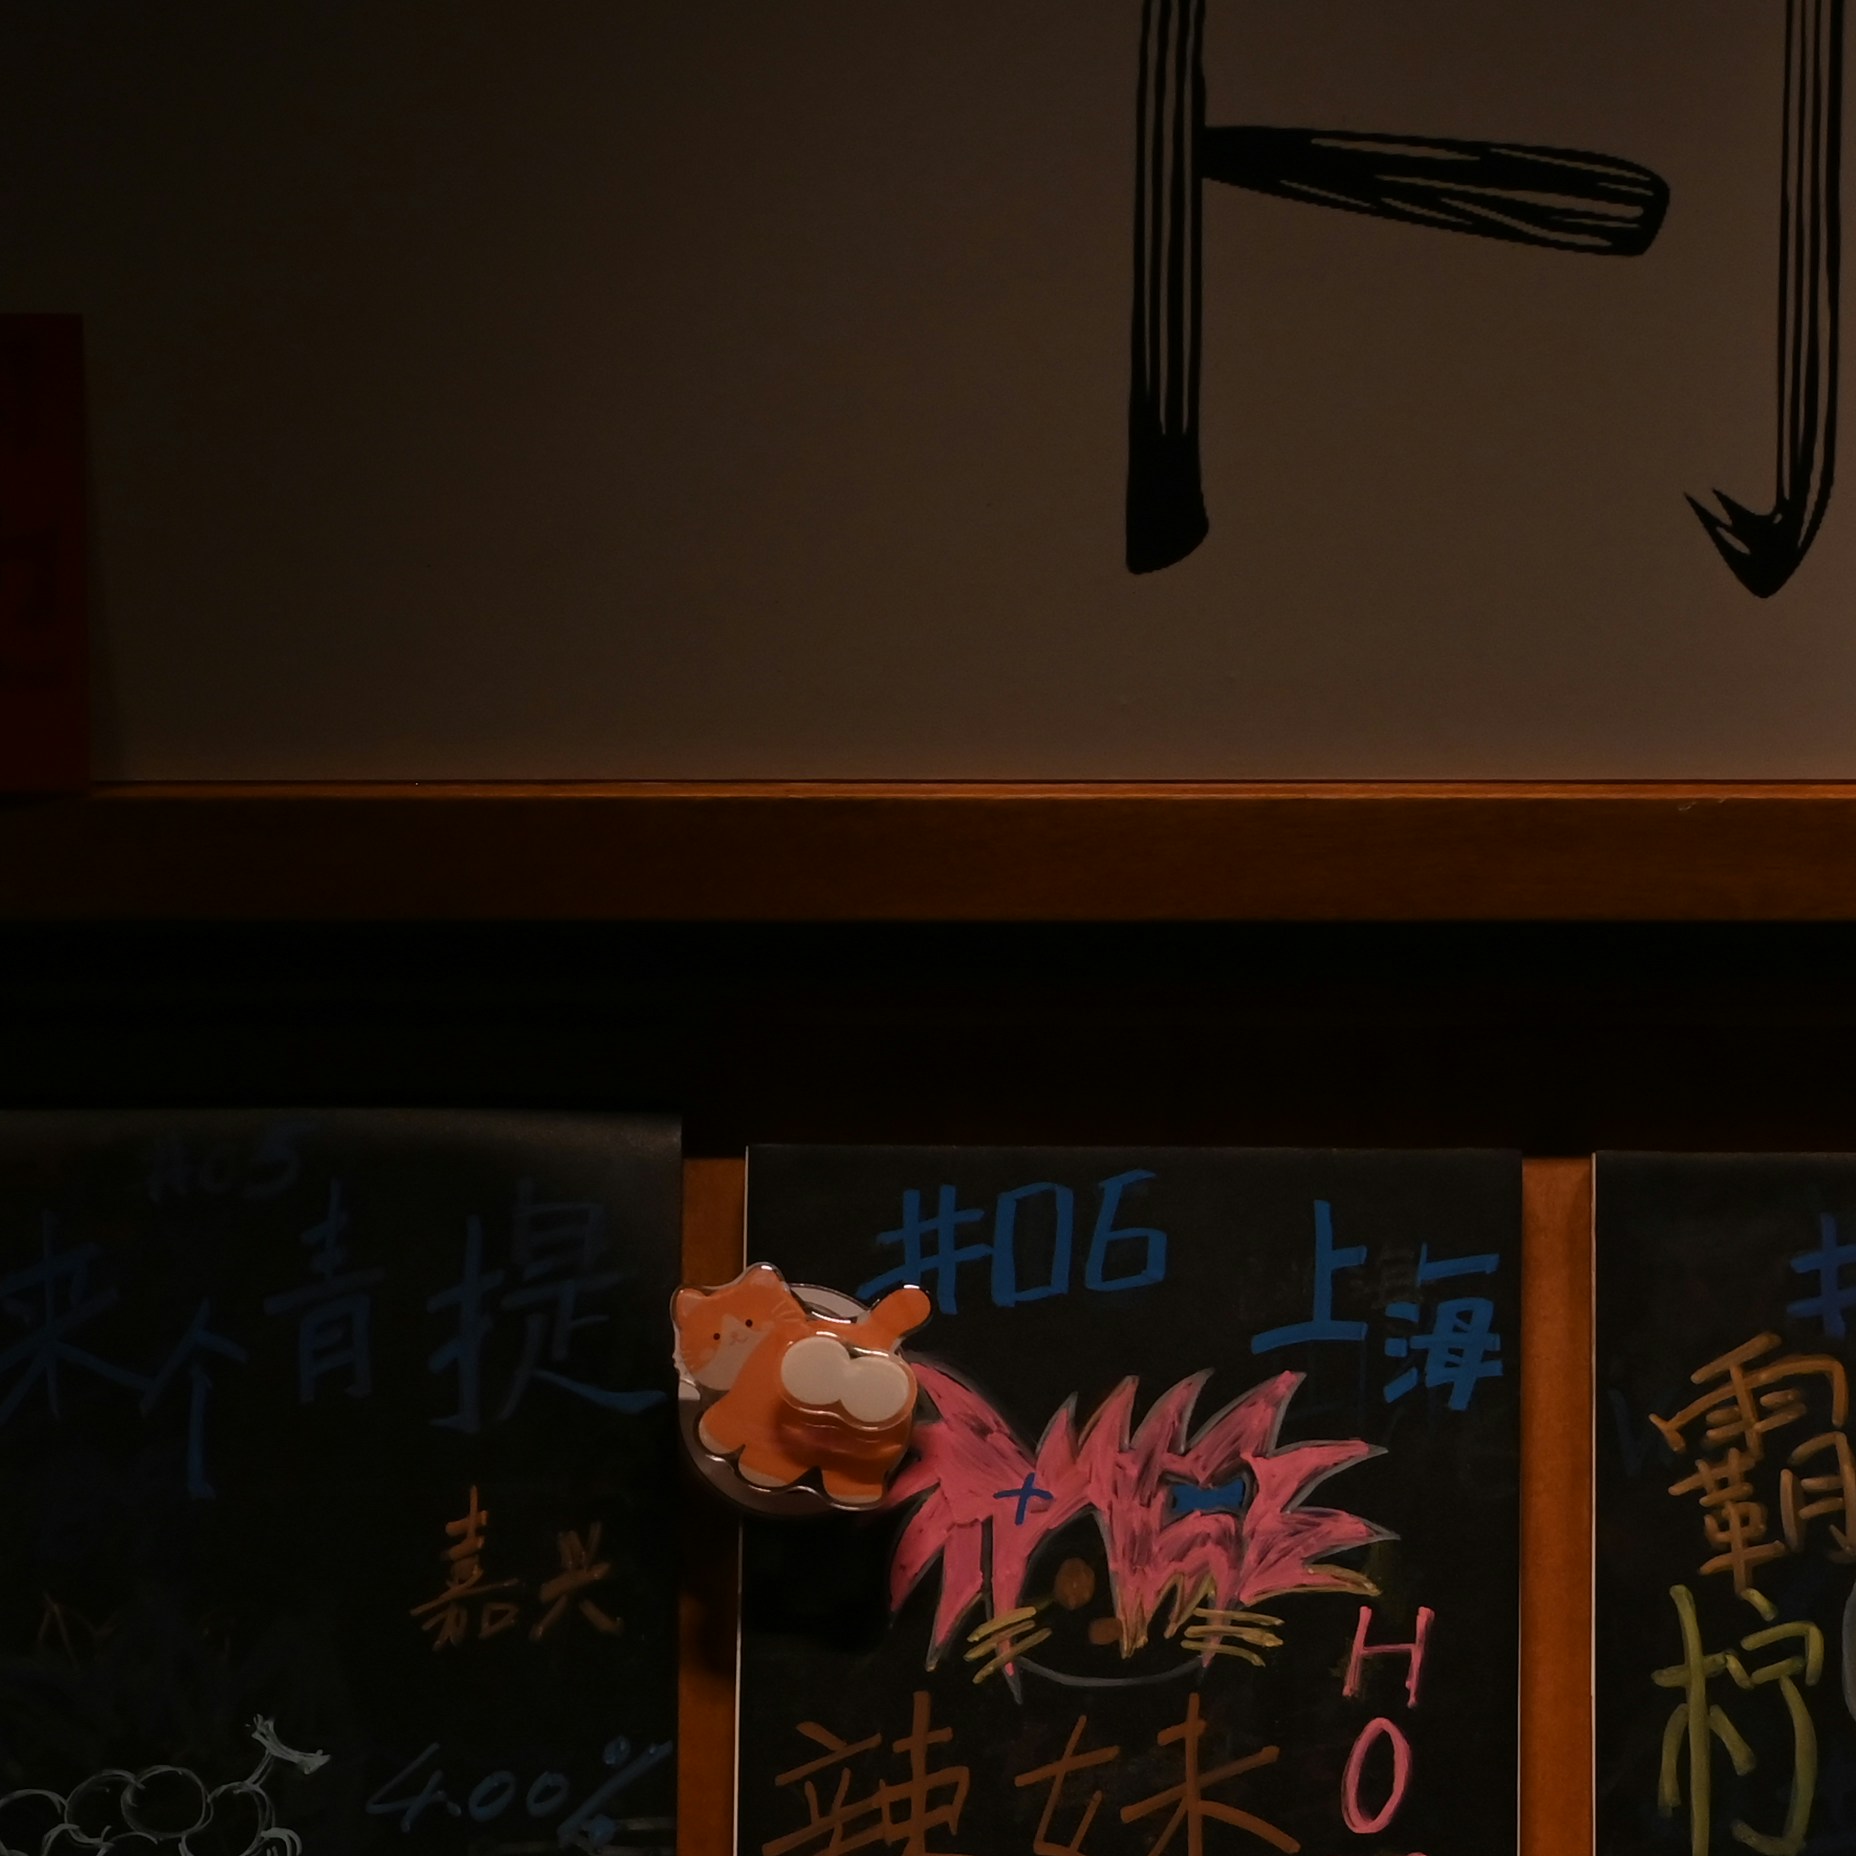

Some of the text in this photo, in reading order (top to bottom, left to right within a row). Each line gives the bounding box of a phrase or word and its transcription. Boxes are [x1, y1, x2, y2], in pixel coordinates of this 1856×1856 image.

[855, 1168, 1167, 1316] #06
[1251, 1199, 1505, 1411] 上海
[410, 1485, 624, 1652] 嘉兴
[365, 1736, 673, 1849] 4.00%
